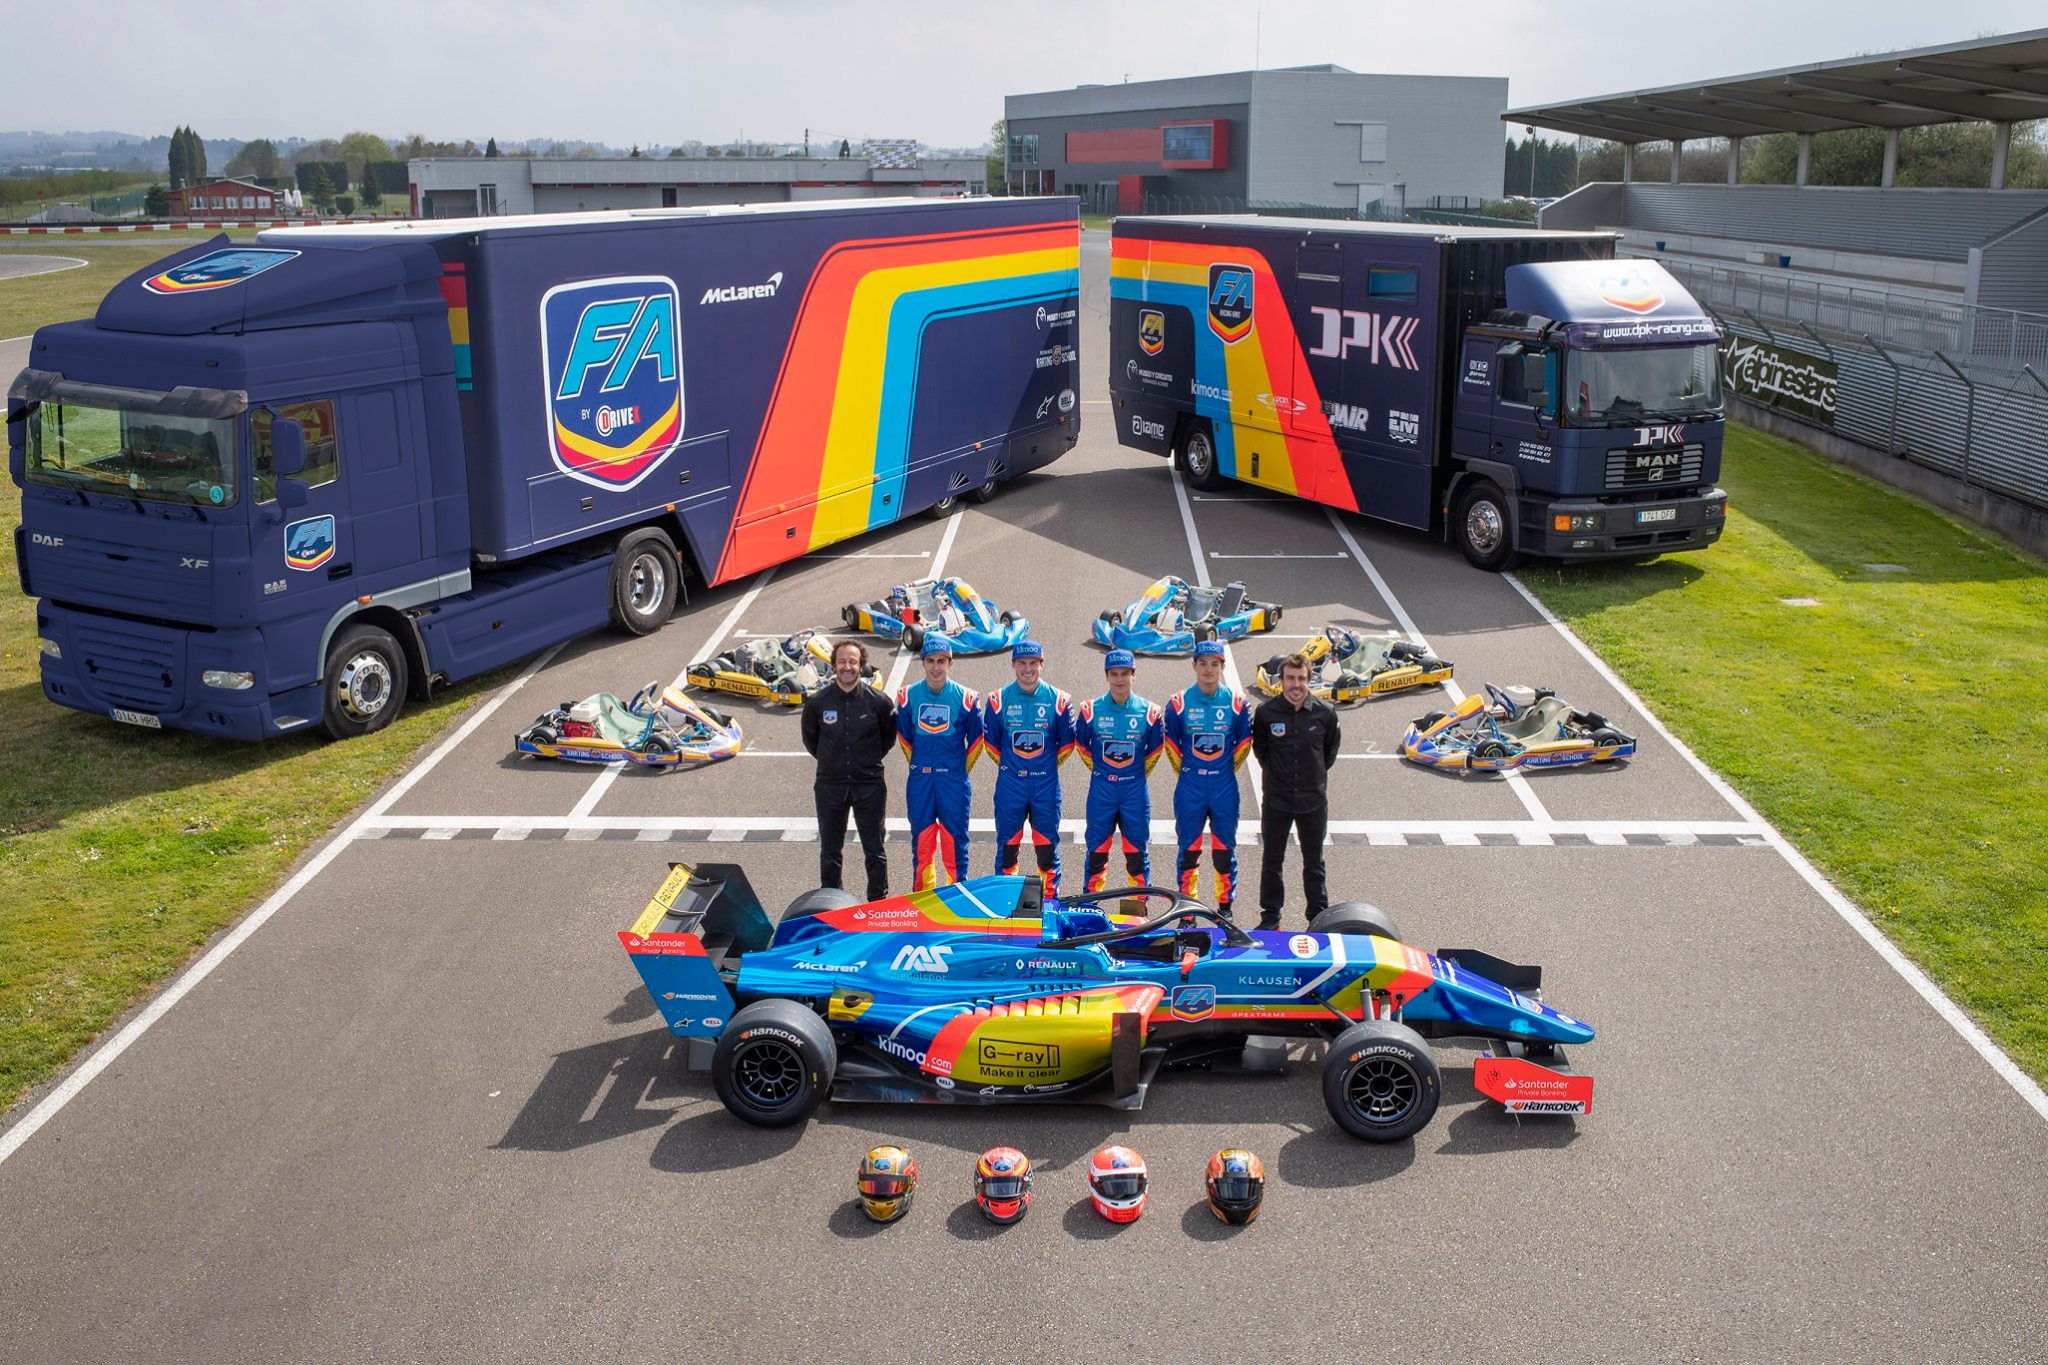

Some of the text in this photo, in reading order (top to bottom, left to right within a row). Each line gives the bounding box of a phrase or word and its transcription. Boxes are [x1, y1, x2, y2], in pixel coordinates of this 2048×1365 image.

[700, 283, 776, 305] McLaren
[1210, 270, 1252, 309] FA
[1142, 314, 1163, 336] FA
[1603, 323, 1713, 339] www.dpk-racing.com
[1309, 306, 1402, 369] DPK
[556, 293, 677, 400] FA
[1061, 350, 1077, 363] SCHOOL
[1742, 349, 1838, 412] alpinestars
[581, 409, 591, 420] BY
[597, 405, 640, 431] DRIVEX
[1633, 425, 1677, 446] DPK
[1636, 454, 1679, 468] MAN
[32, 533, 65, 547] DAF
[287, 518, 333, 551] FA
[179, 557, 210, 569] XF
[720, 681, 761, 694] RENAULT
[1378, 675, 1419, 690] RENAULT
[566, 750, 624, 759] KARTING SCHOOL
[1526, 754, 1585, 764] KARTING SCHOOL
[659, 871, 683, 903] RENAULT
[868, 908, 920, 919] Santander
[1068, 906, 1105, 915] kimo
[867, 919, 918, 928] Private Banking
[641, 939, 687, 948] Santander
[1297, 937, 1310, 954] BELL
[792, 961, 860, 973] McLaren
[1028, 961, 1078, 969] RENAULT
[1238, 976, 1302, 986] KLAUSEN
[1174, 988, 1213, 1006] FA
[878, 1034, 952, 1071] kimoa.com
[979, 1066, 1061, 1078] Make it clear
[938, 1078, 952, 1087] BELL
[1518, 1080, 1569, 1089] Santander
